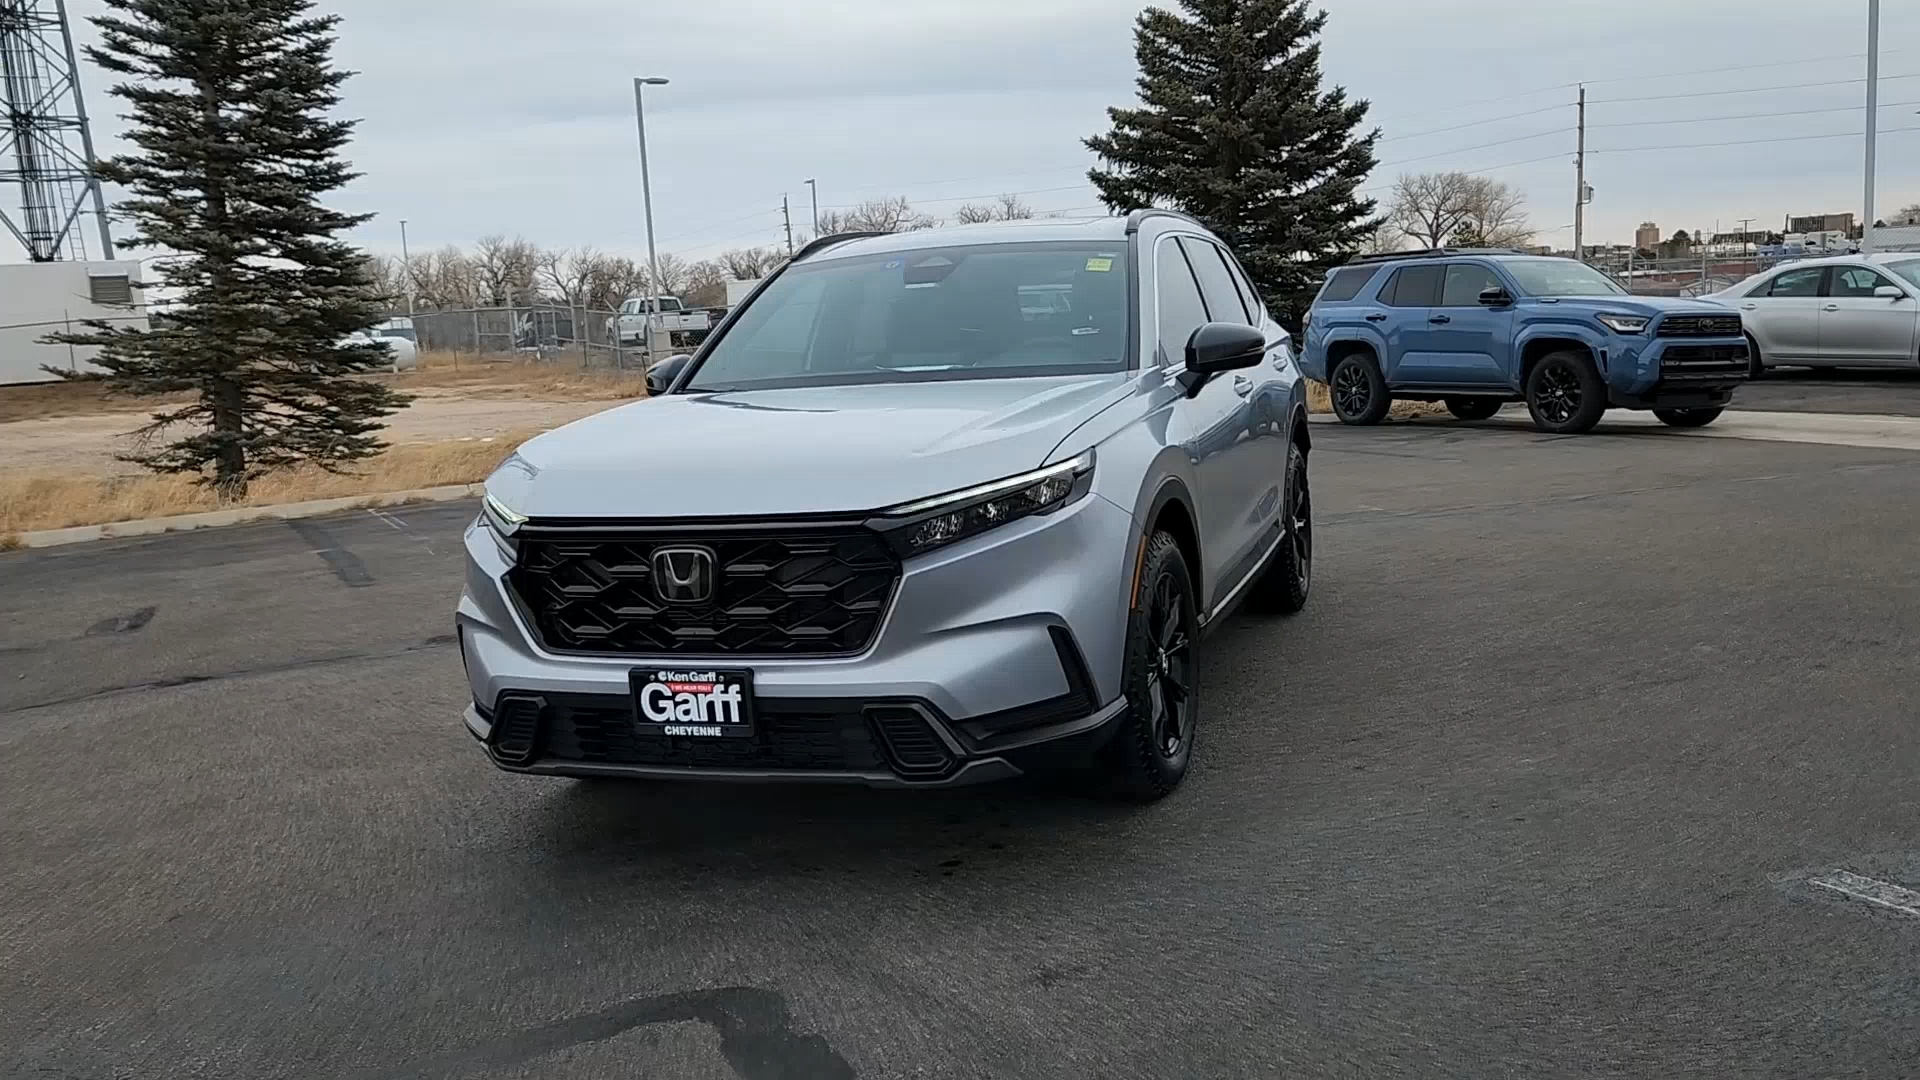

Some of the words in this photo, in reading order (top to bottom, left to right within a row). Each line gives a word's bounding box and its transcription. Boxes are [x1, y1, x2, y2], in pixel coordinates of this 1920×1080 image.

[667, 671, 689, 682] Ken
[689, 671, 717, 682] Garff
[640, 682, 742, 722] Garff
[664, 725, 722, 736] CHEYENNE
